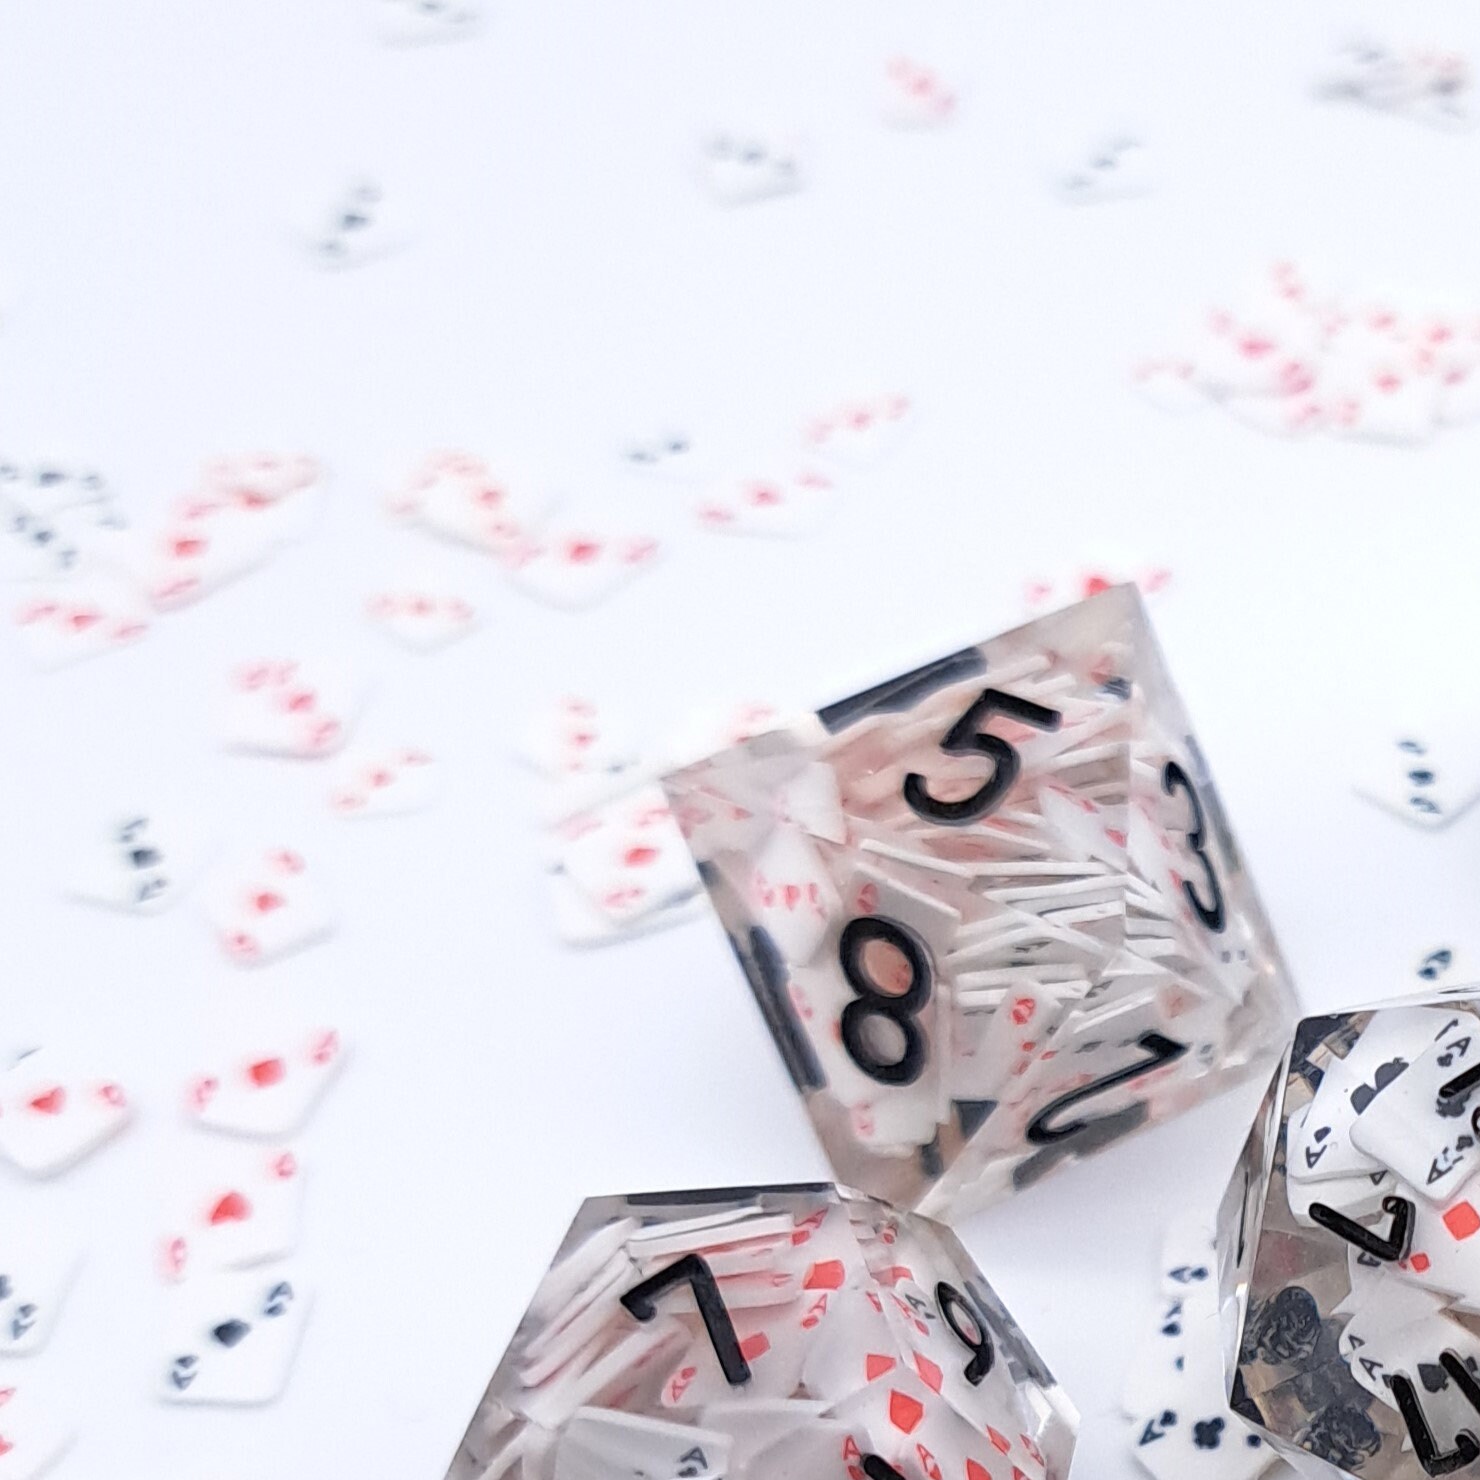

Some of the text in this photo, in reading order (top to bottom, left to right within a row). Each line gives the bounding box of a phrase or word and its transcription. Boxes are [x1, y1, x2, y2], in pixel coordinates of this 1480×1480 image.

[904, 687, 1062, 827] 5
[1161, 760, 1226, 933] 3
[839, 915, 932, 1086] 8
[1446, 1036, 1471, 1057] A
[1305, 1144, 1327, 1168] A
[1308, 1196, 1416, 1262] 7
[620, 1253, 750, 1386] 7
[934, 1281, 995, 1387] 9
[1359, 1357, 1384, 1381] A
[842, 1434, 862, 1460] A
[1139, 1419, 1165, 1446] A
[679, 1447, 708, 1469] A
